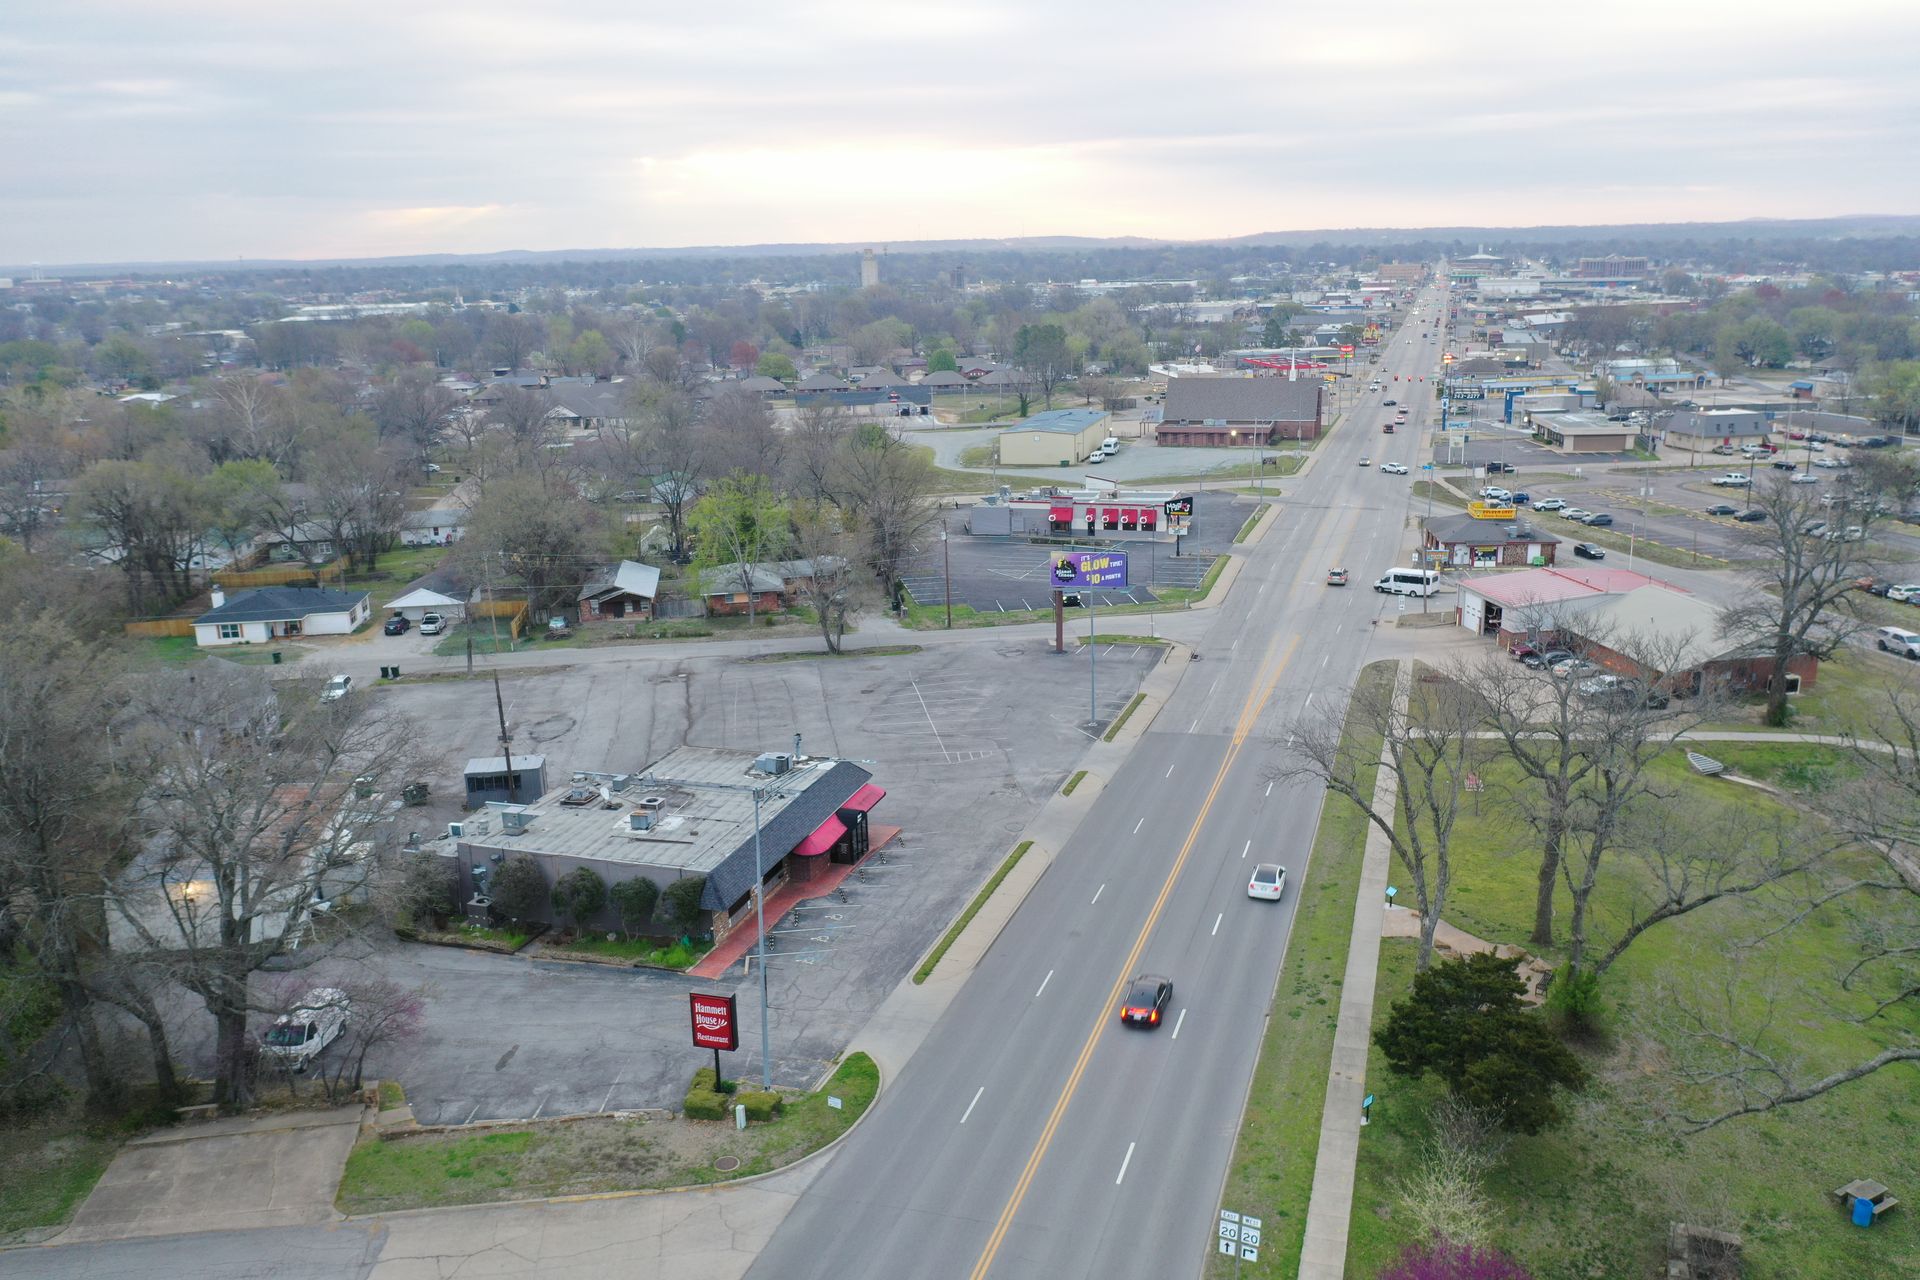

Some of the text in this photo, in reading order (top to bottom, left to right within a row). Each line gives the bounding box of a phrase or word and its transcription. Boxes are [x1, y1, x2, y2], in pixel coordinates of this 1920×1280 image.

[1081, 557, 1110, 572] GLOW
[695, 1002, 727, 1016] Hammett
[696, 1014, 717, 1025] House
[697, 1032, 729, 1043] Restaurant
[1223, 1212, 1237, 1220] EAST
[1245, 1217, 1259, 1226] WEST
[1221, 1227, 1236, 1238] 20
[1243, 1232, 1258, 1244] 20
